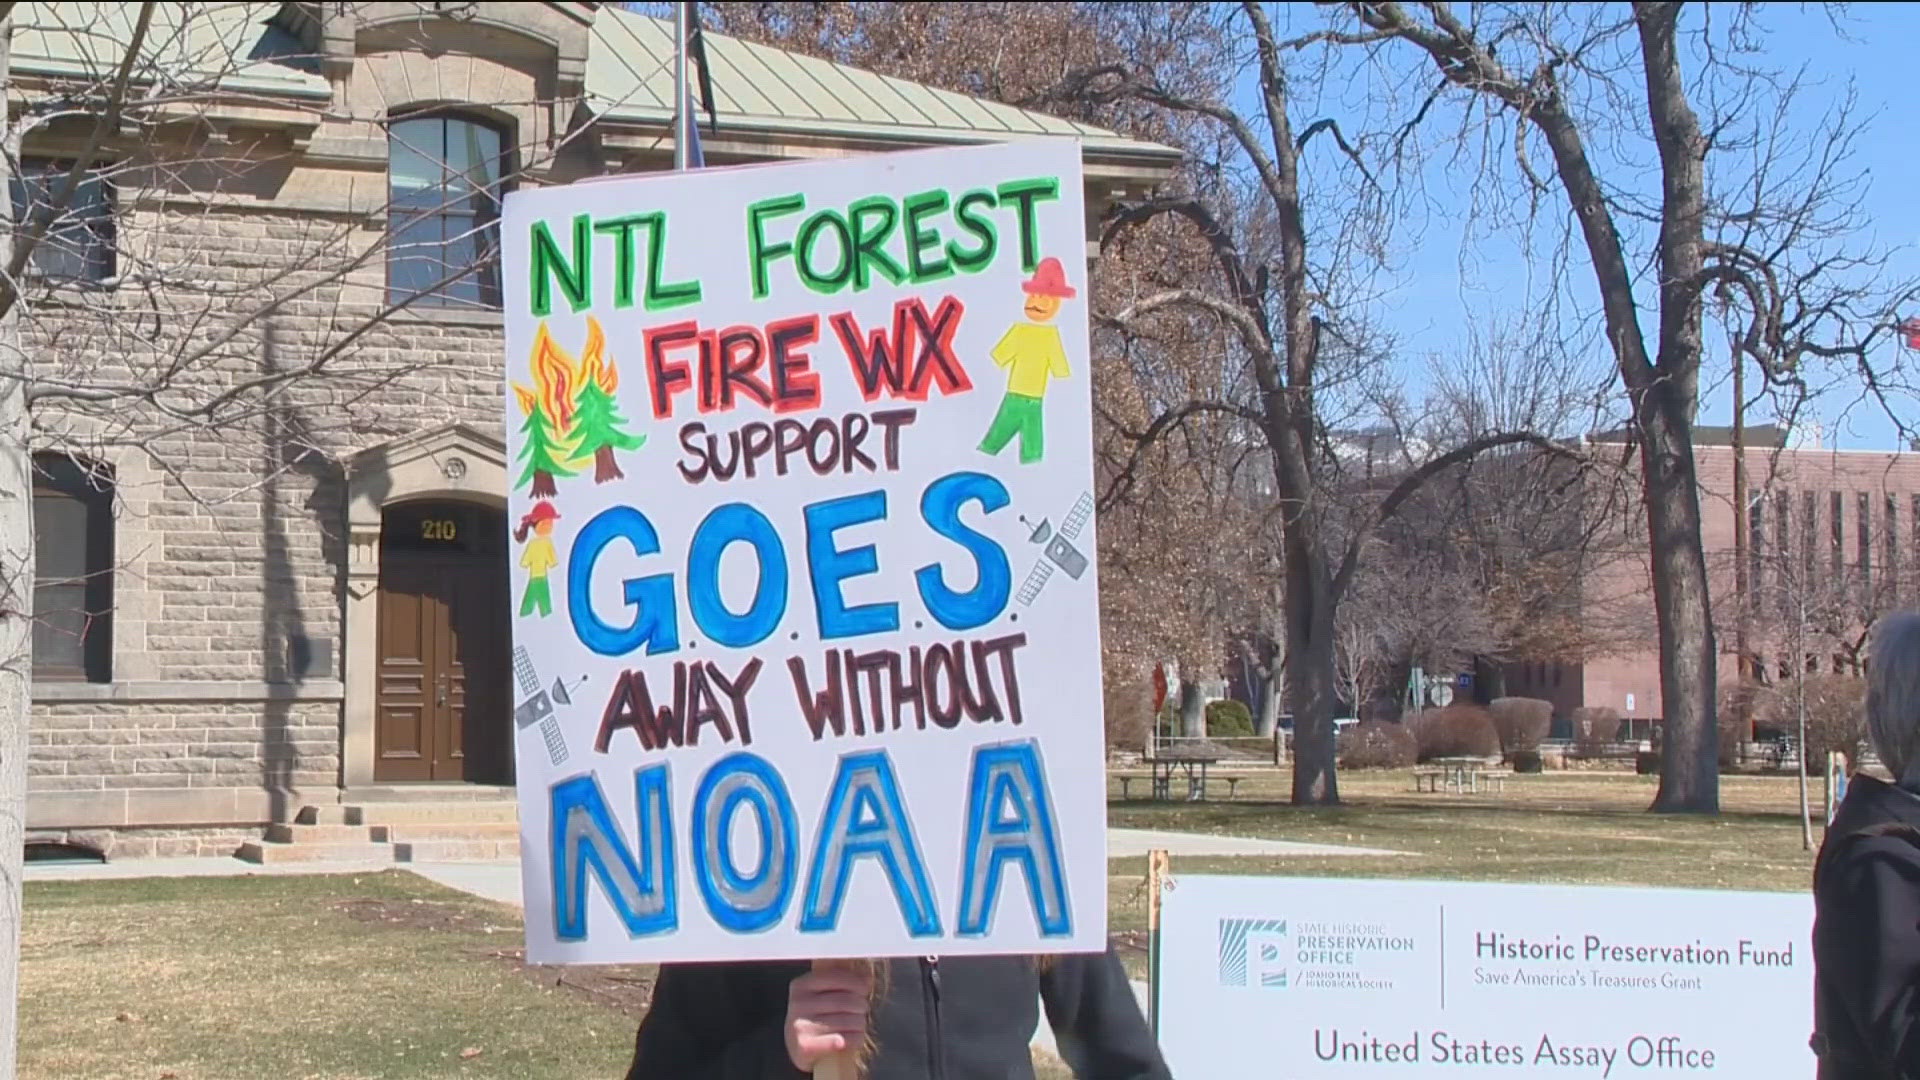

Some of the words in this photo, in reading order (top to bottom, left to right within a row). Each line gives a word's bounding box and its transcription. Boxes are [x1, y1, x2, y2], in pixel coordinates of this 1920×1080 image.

[530, 211, 699, 316] NTL
[747, 177, 1060, 299] FOREST
[642, 314, 822, 420] FIRE
[829, 295, 974, 402] WX
[677, 408, 917, 484] SUPPORT
[422, 520, 456, 540] 210
[594, 656, 763, 754] AWAY
[787, 633, 1026, 740] WITHOUT
[549, 737, 1074, 943] NOAA
[1296, 922, 1329, 934] STATE
[1332, 923, 1387, 936] HISTORIC
[1297, 935, 1414, 951] PRESERVATION
[1475, 931, 1575, 960] Historic
[1584, 935, 1730, 965] Preservation
[1739, 940, 1793, 967] Fund
[1297, 950, 1353, 964] OFFICE
[1473, 967, 1510, 985] Save
[1513, 968, 1586, 987] America's
[1591, 970, 1657, 989] Treasures
[1660, 971, 1701, 990] Grant
[1314, 1029, 1420, 1063] United
[1431, 1031, 1524, 1065] States
[1533, 1033, 1617, 1079] Assay
[1626, 1035, 1716, 1068] Office
